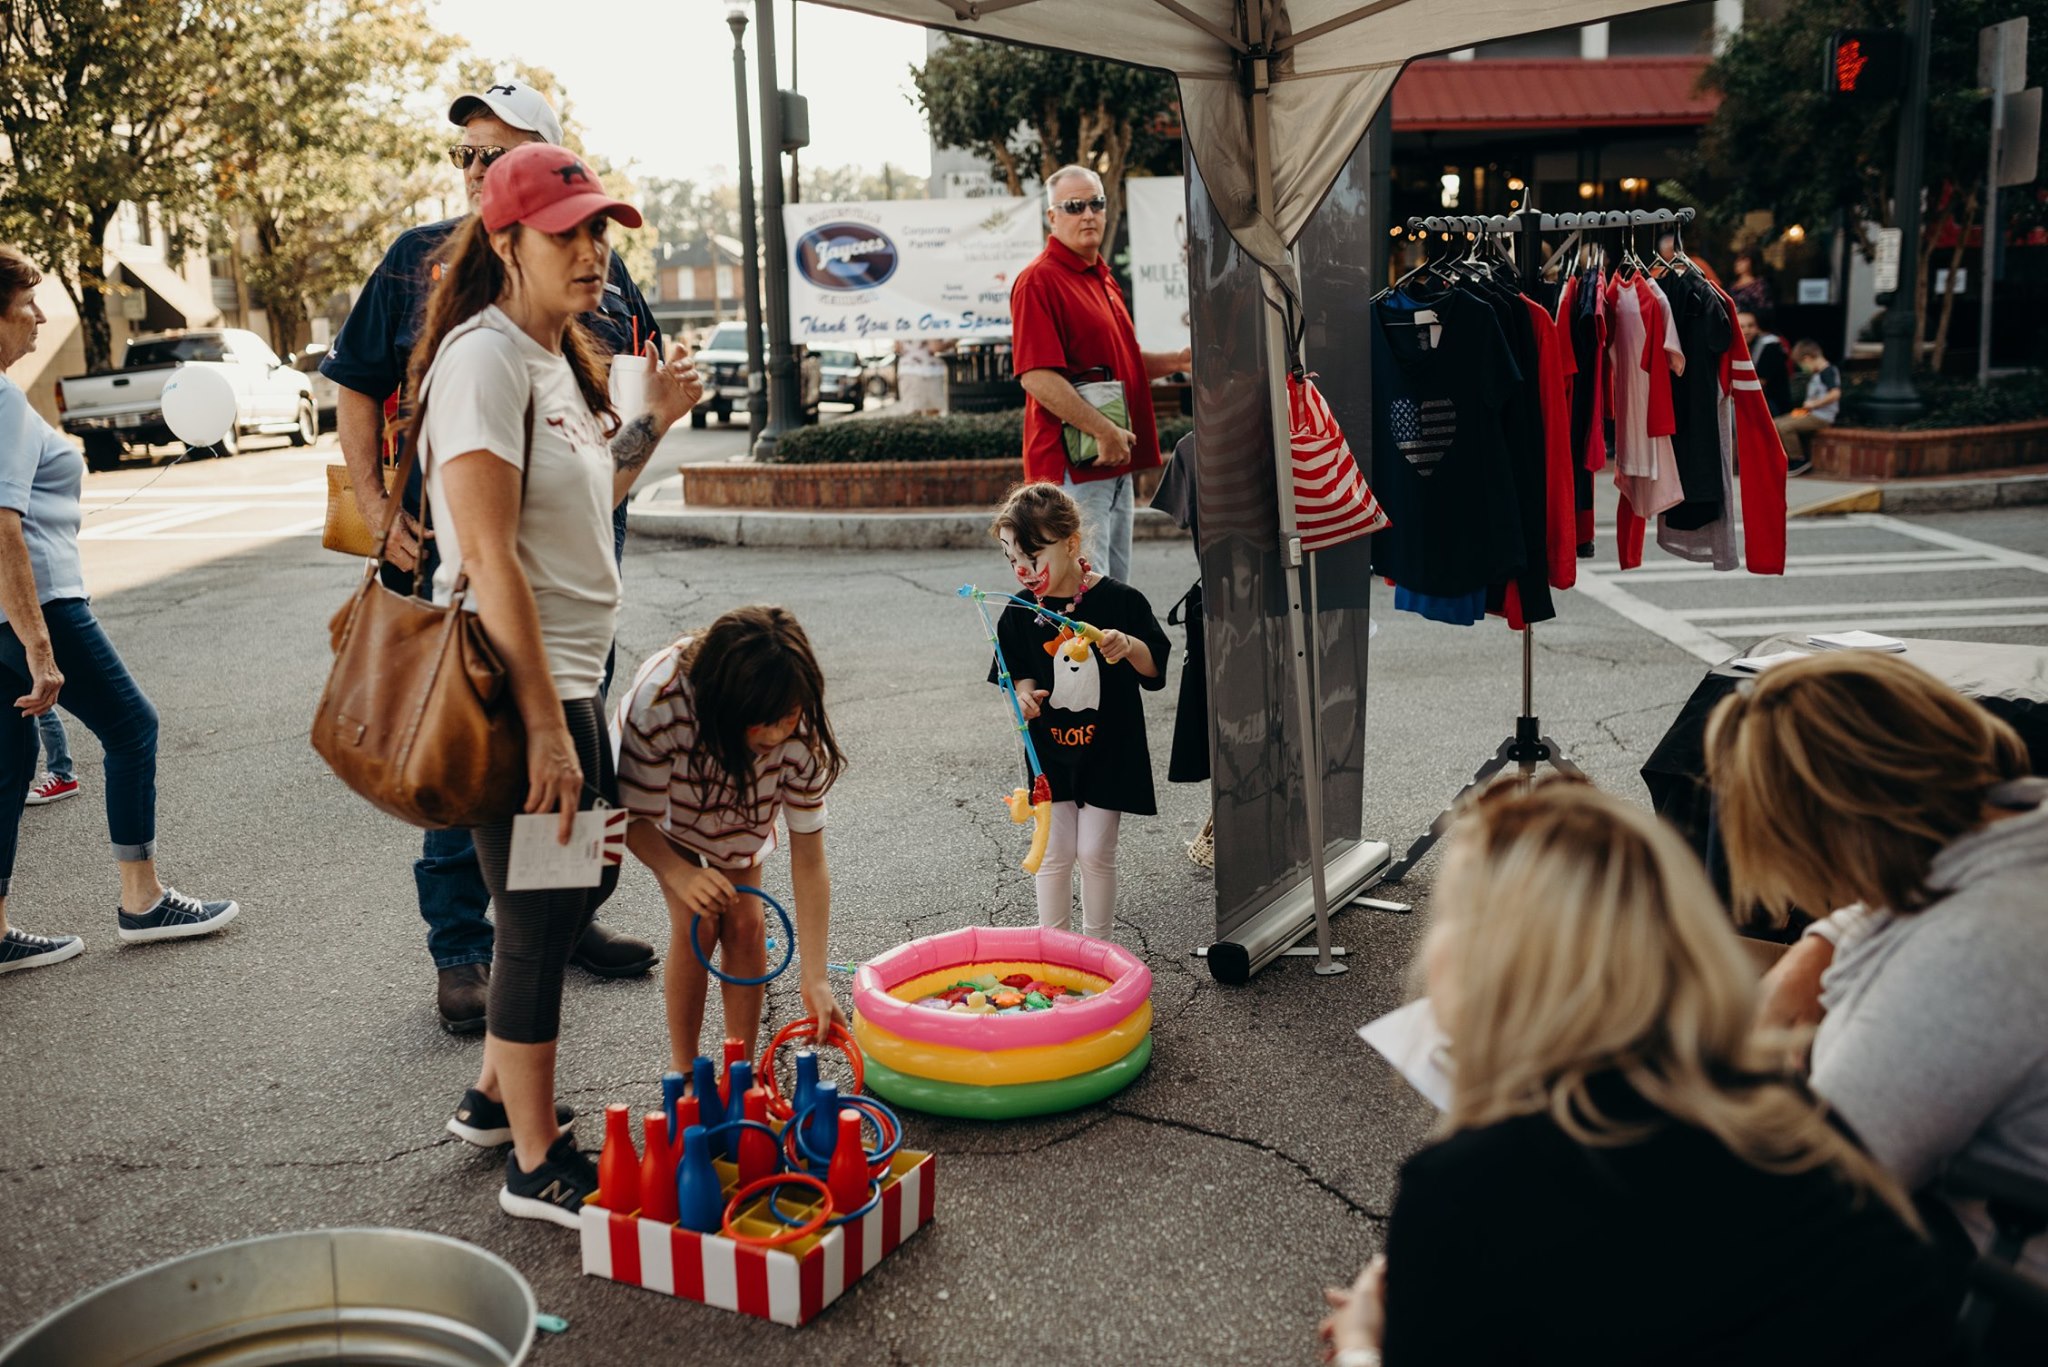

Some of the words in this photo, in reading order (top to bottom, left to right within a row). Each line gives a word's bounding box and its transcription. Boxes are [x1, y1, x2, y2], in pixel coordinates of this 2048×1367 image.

[902, 226, 951, 237] Corporate
[815, 237, 887, 271] Jaycees
[908, 240, 946, 250] Partner
[800, 316, 847, 334] Thank
[855, 313, 889, 338] You
[896, 317, 911, 331] to
[918, 313, 950, 330] Our
